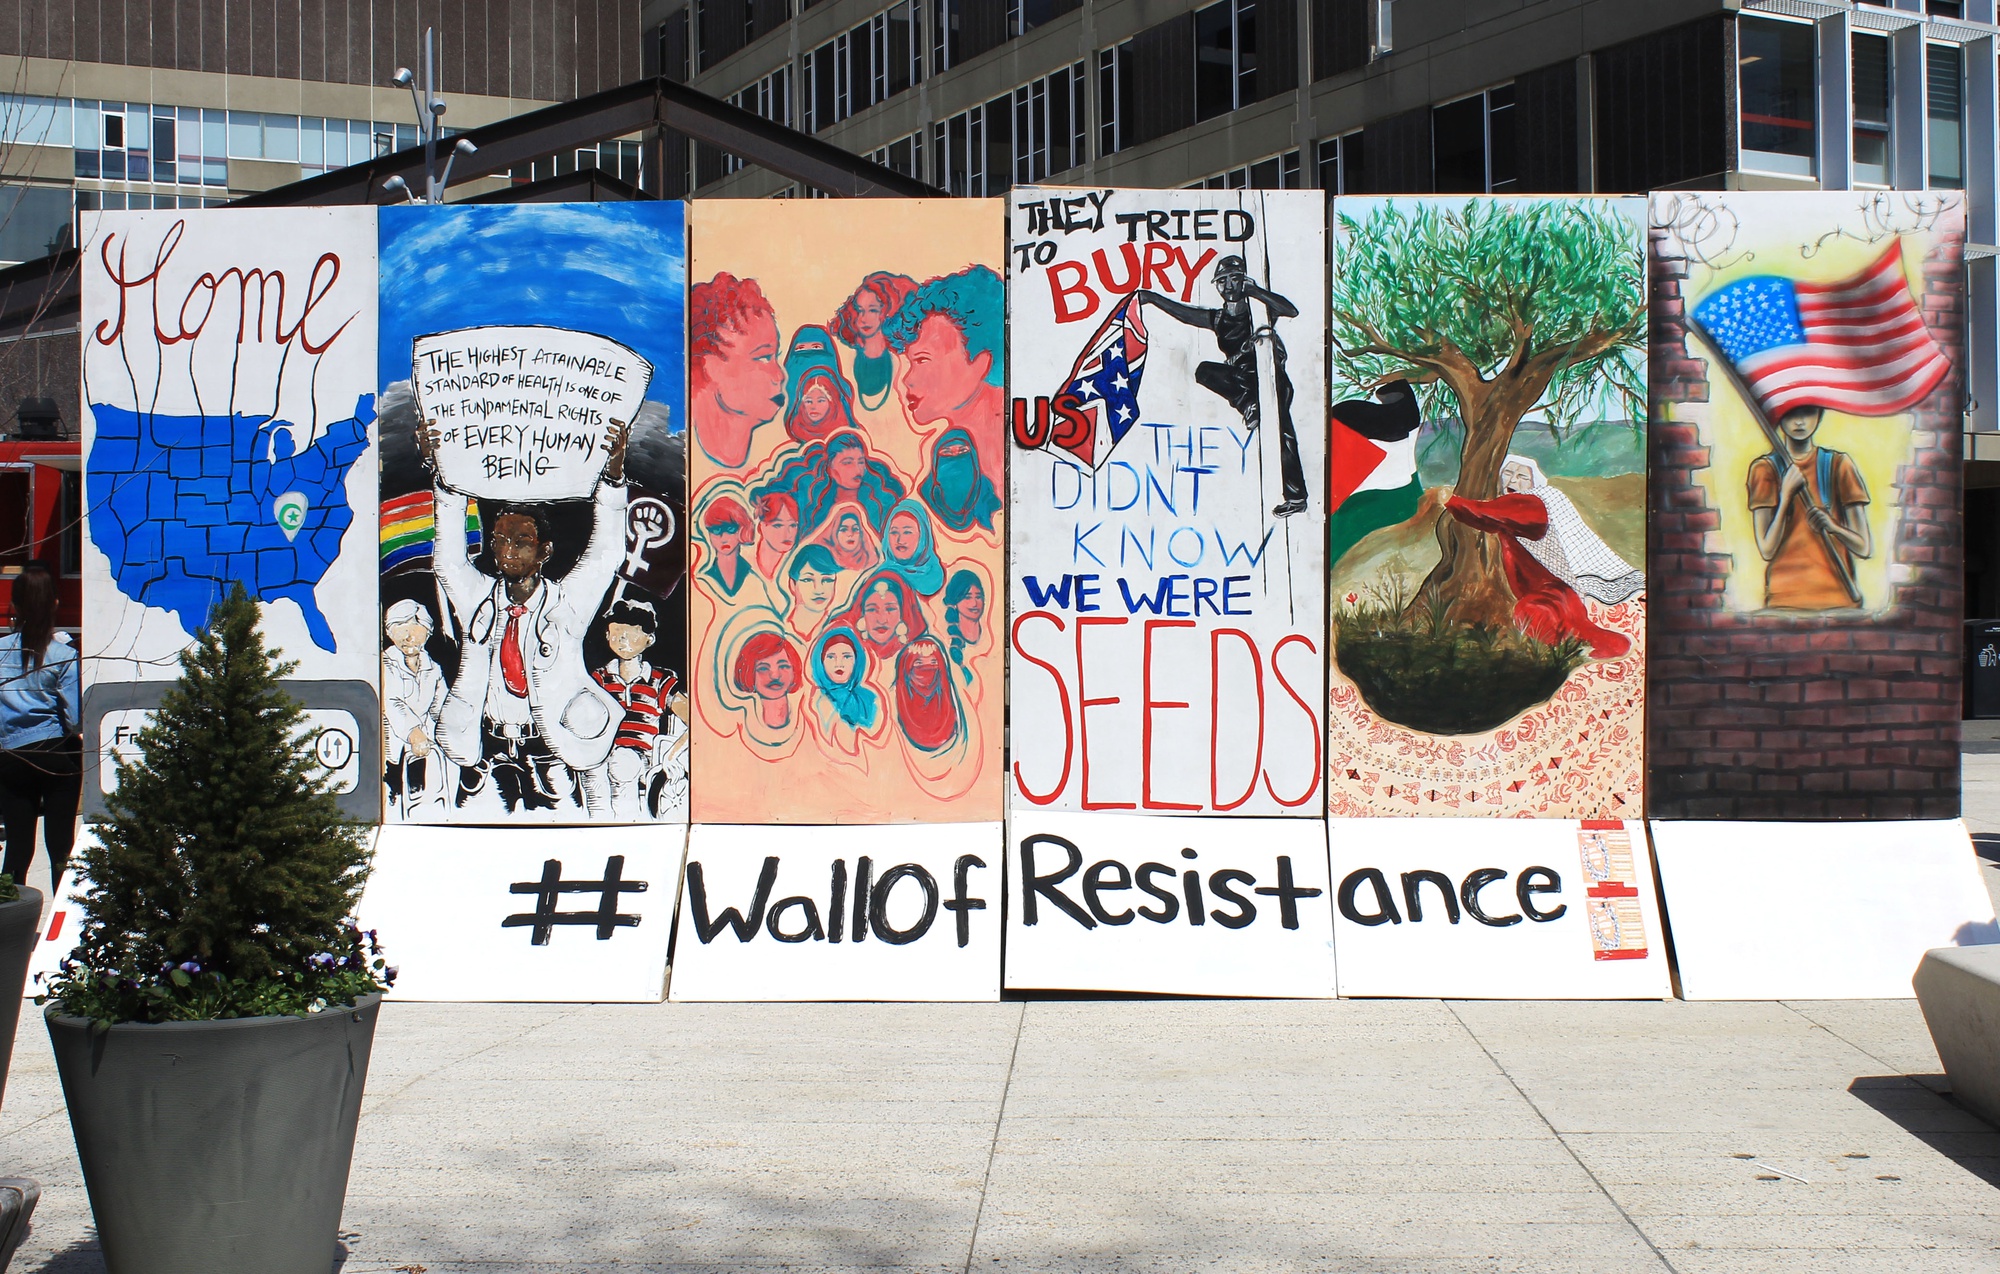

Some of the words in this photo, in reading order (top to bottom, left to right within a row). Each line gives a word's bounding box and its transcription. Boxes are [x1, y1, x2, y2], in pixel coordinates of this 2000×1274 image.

[1018, 190, 1114, 235] THEY
[1115, 209, 1255, 242] TRIED
[96, 219, 361, 355] Home
[1013, 241, 1058, 274] TO
[1046, 241, 1218, 324] BURY
[419, 349, 464, 375] THE
[467, 344, 528, 371] HIGHEST
[532, 348, 627, 383] ATTAINABLE
[424, 372, 500, 396] STANDARD
[502, 373, 516, 386] OF
[517, 374, 564, 397] HEALTH
[565, 381, 576, 393] IS
[578, 385, 600, 401] ONE
[601, 391, 623, 404] OF
[430, 403, 456, 419] THE
[460, 397, 553, 421] FUNDAMENTAL
[558, 404, 603, 426] RIGHTS
[1012, 394, 1091, 450] US
[443, 428, 459, 443] OF
[464, 425, 530, 453] EVERY
[532, 430, 595, 463] HUMAN
[481, 451, 561, 485] BEING
[1140, 423, 1256, 475] THEY
[1073, 521, 1276, 571] KNOW
[1022, 574, 1101, 612] WE
[1117, 574, 1253, 616] WERE
[1011, 610, 1321, 811] SEEDS
